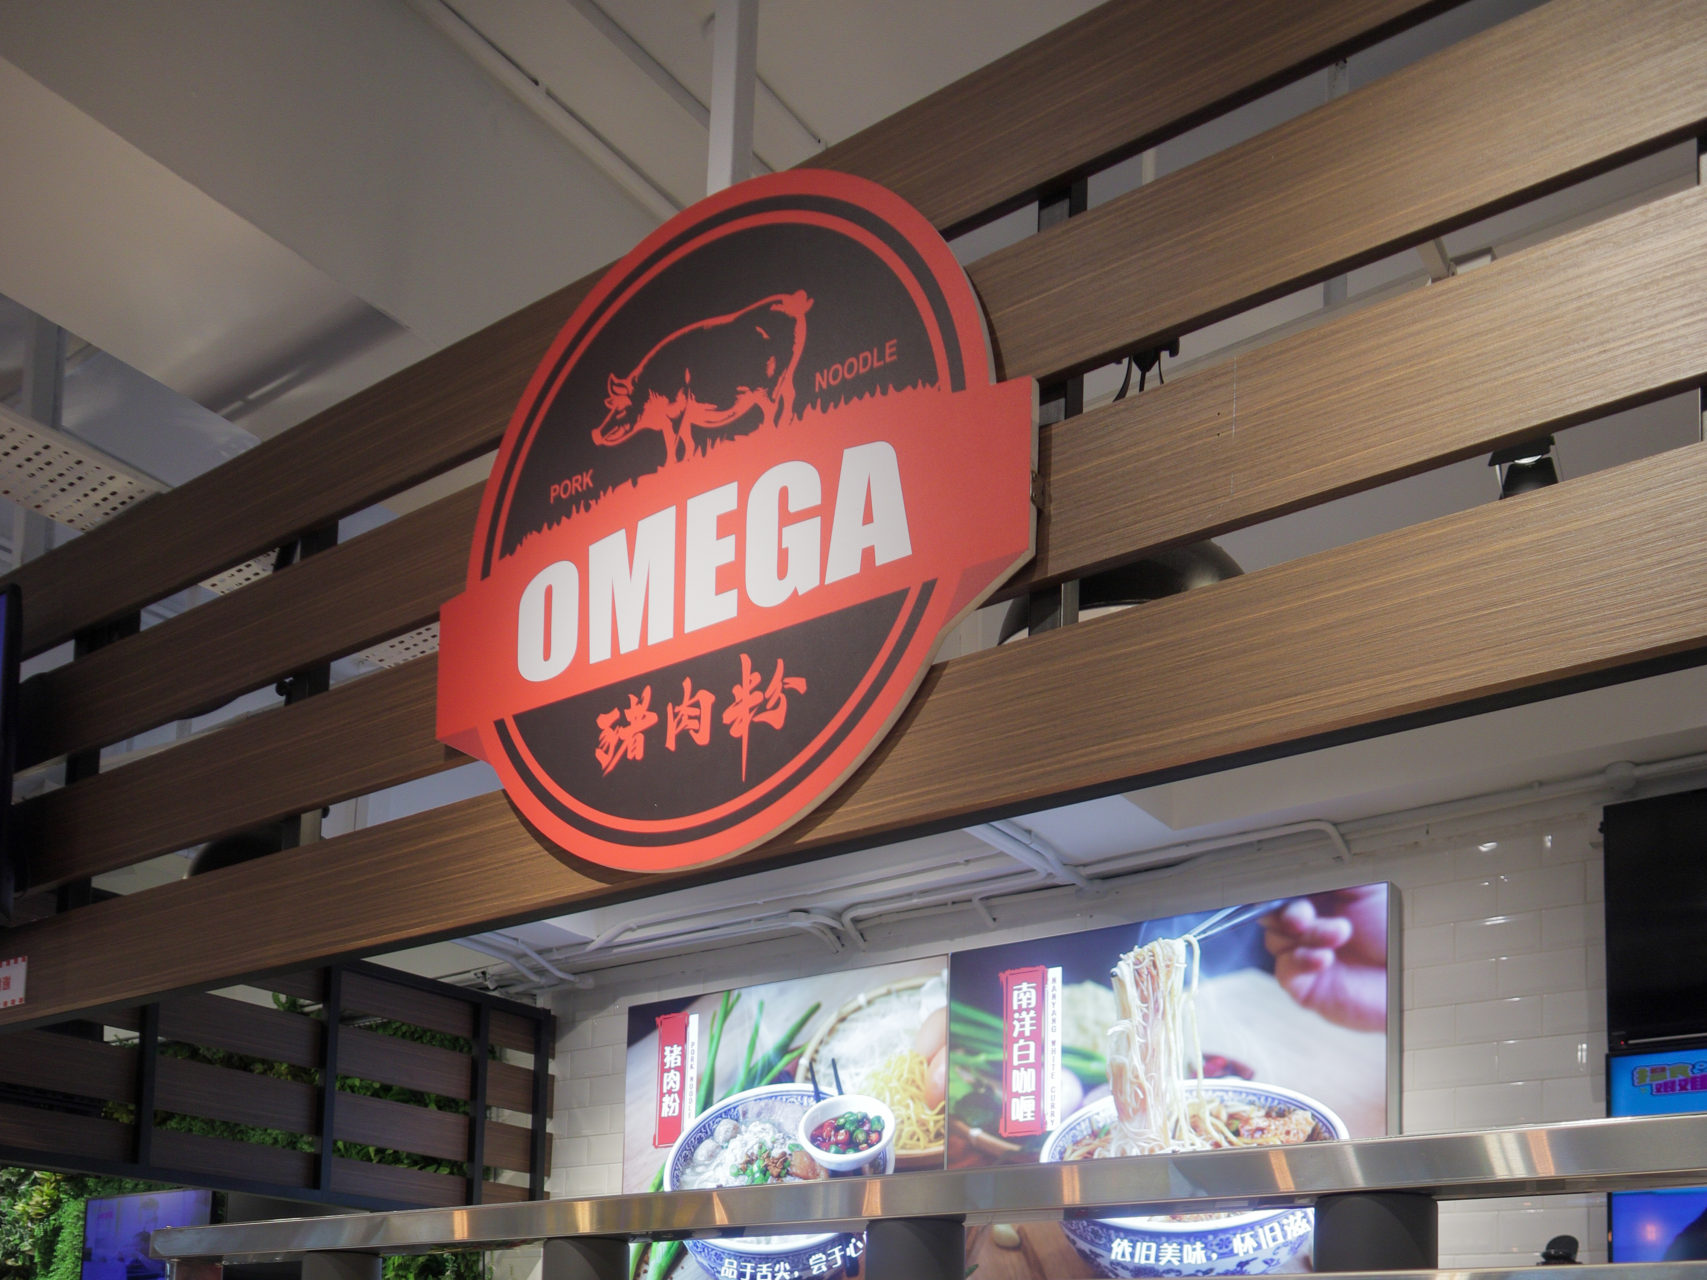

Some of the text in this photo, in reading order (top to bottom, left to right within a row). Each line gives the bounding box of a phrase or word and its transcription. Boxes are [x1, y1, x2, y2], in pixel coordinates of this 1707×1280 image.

[814, 338, 899, 393] NOODLE
[548, 469, 595, 504] PORK
[516, 440, 914, 683] OMEGA
[594, 653, 808, 783] 豬肉粉
[660, 1044, 682, 1118] 猪肉粉
[1011, 982, 1037, 1122] 南洋白咖喱
[1110, 1208, 1315, 1266] 依旧美味，怀旧滋
